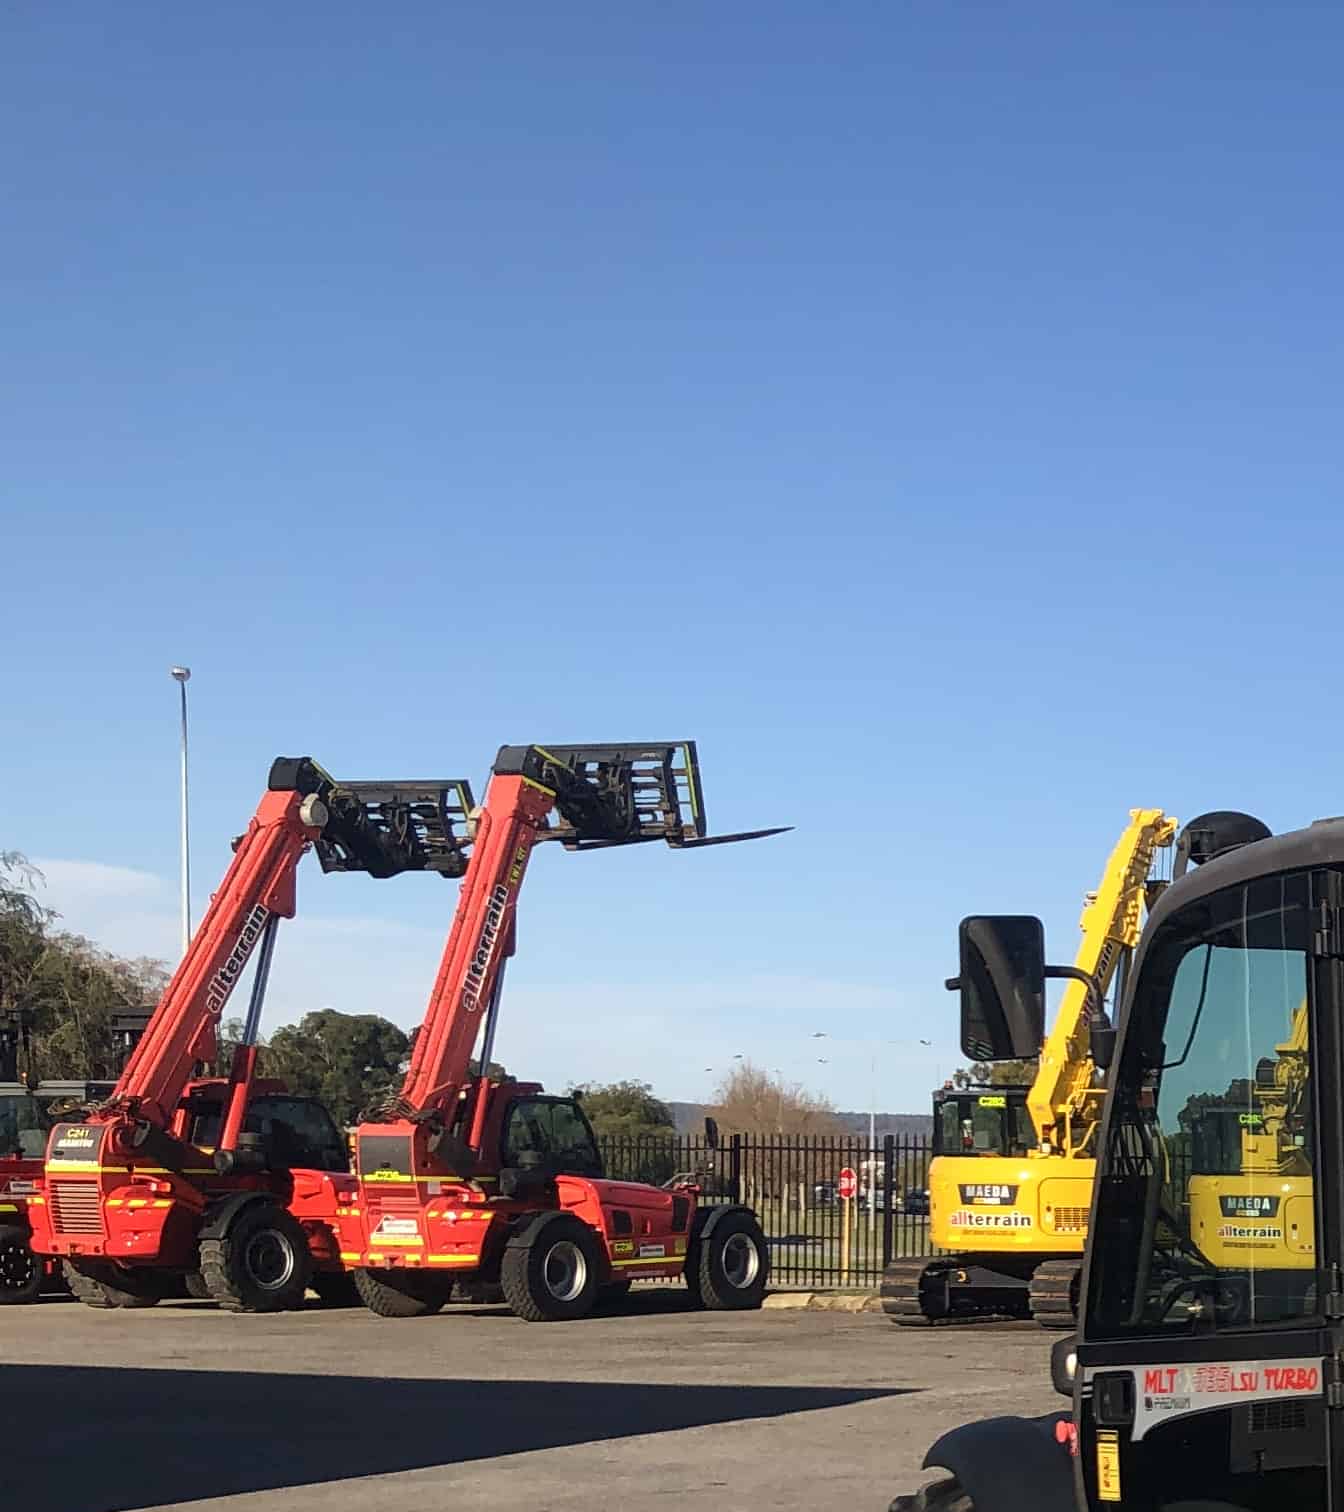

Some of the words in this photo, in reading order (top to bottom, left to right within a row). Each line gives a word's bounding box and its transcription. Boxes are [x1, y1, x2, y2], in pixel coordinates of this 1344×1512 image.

[463, 883, 508, 1011] allterrain
[206, 903, 269, 1013] allterrain
[965, 1185, 1010, 1198] MAEDA
[1227, 1197, 1271, 1210] MAEDA
[951, 1212, 1032, 1227] allterrain
[1217, 1225, 1281, 1238] allterrain
[1264, 1367, 1318, 1392] TURBO
